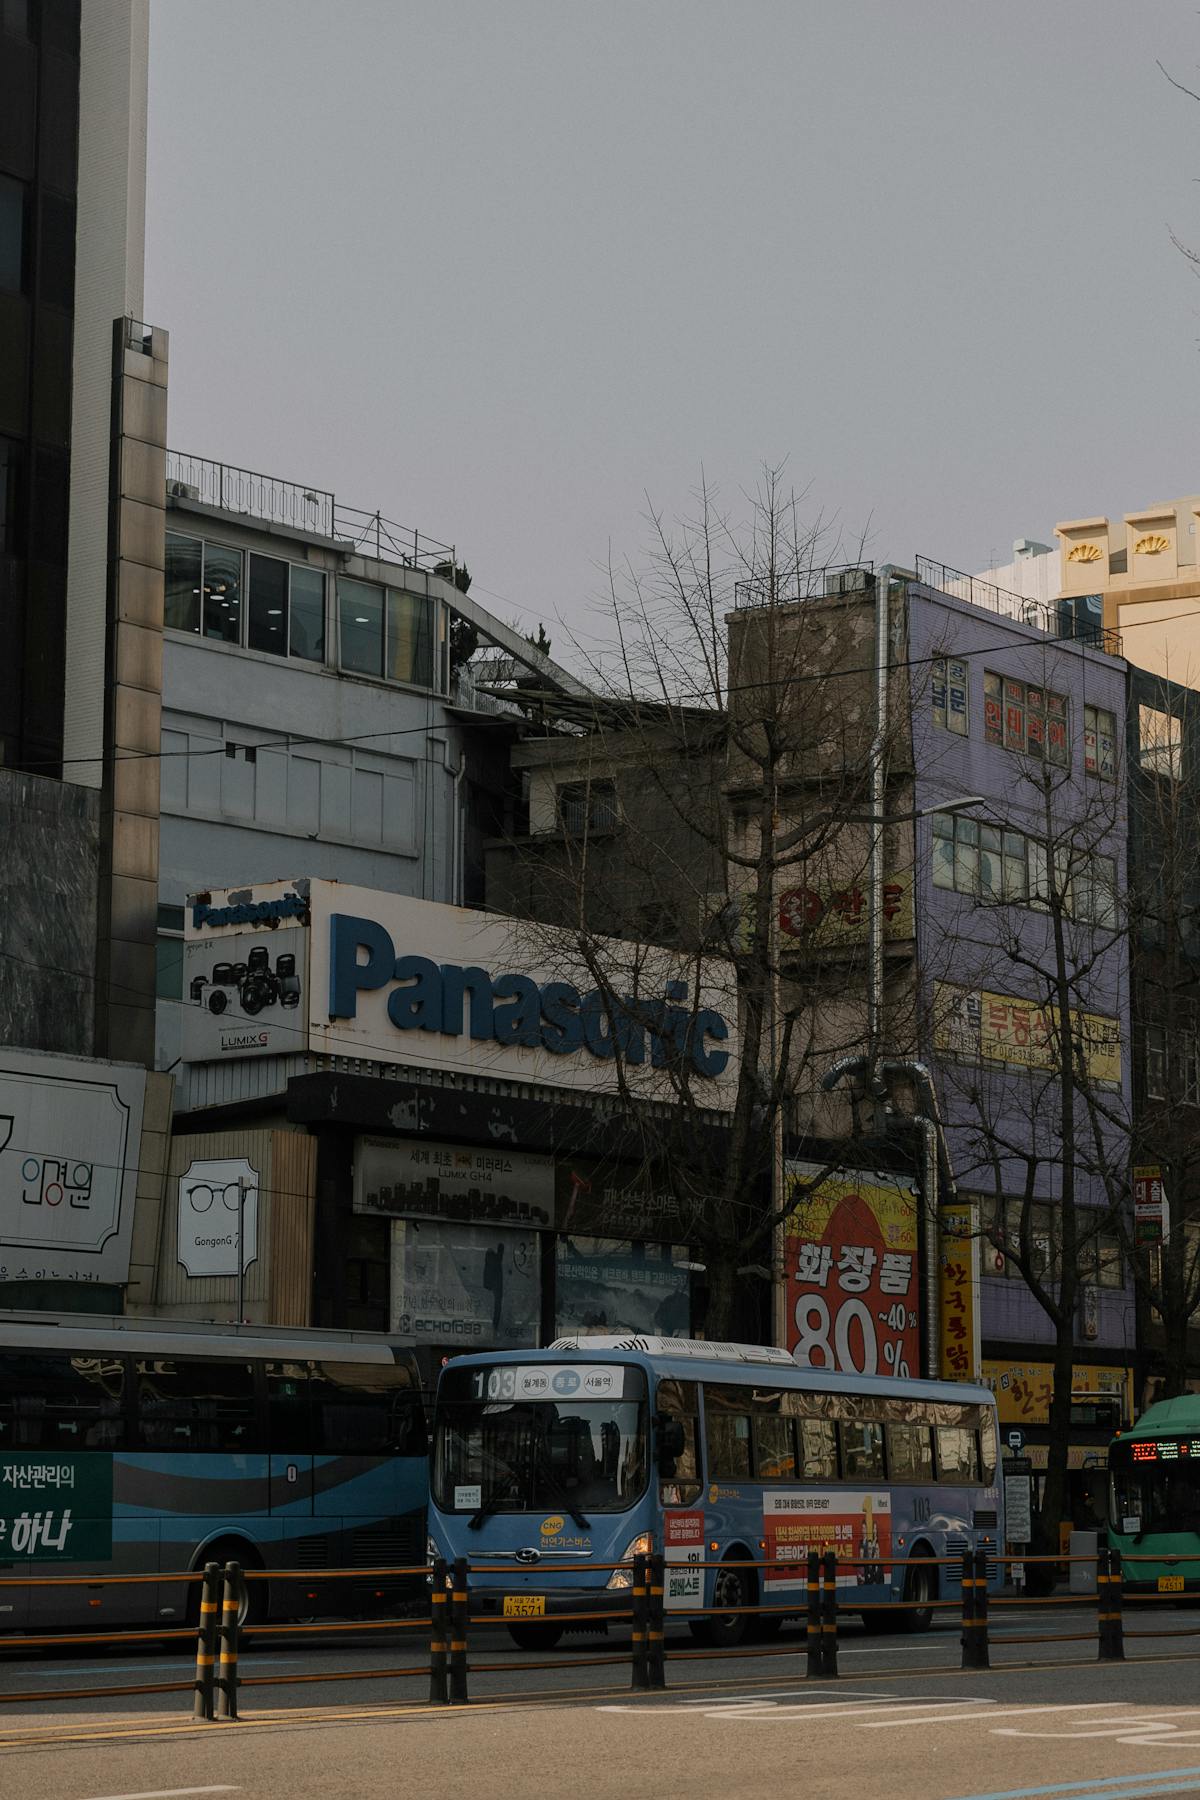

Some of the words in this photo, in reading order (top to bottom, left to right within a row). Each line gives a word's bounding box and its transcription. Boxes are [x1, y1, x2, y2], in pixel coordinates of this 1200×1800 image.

[192, 892, 306, 929] Panasonic
[329, 913, 729, 1077] Panasonic
[221, 1035, 257, 1047] LUMIX
[258, 1032, 268, 1042] G
[410, 1150, 430, 1165] 세계
[433, 1151, 453, 1167] 최초
[476, 1155, 513, 1172] 미러리스
[438, 1167, 468, 1180] LUMIX
[470, 1171, 493, 1182] GH4
[194, 1235, 232, 1248] GongonG
[795, 1243, 912, 1295] 화장품
[943, 1263, 969, 1371] 한국통닭
[473, 1370, 516, 1398] 103
[585, 1377, 611, 1388] 서울역
[3, 1464, 75, 1489] 자산관리의
[11, 1509, 73, 1554] 하나
[543, 1522, 562, 1530] CNG
[540, 1536, 593, 1548] 천연가스버스
